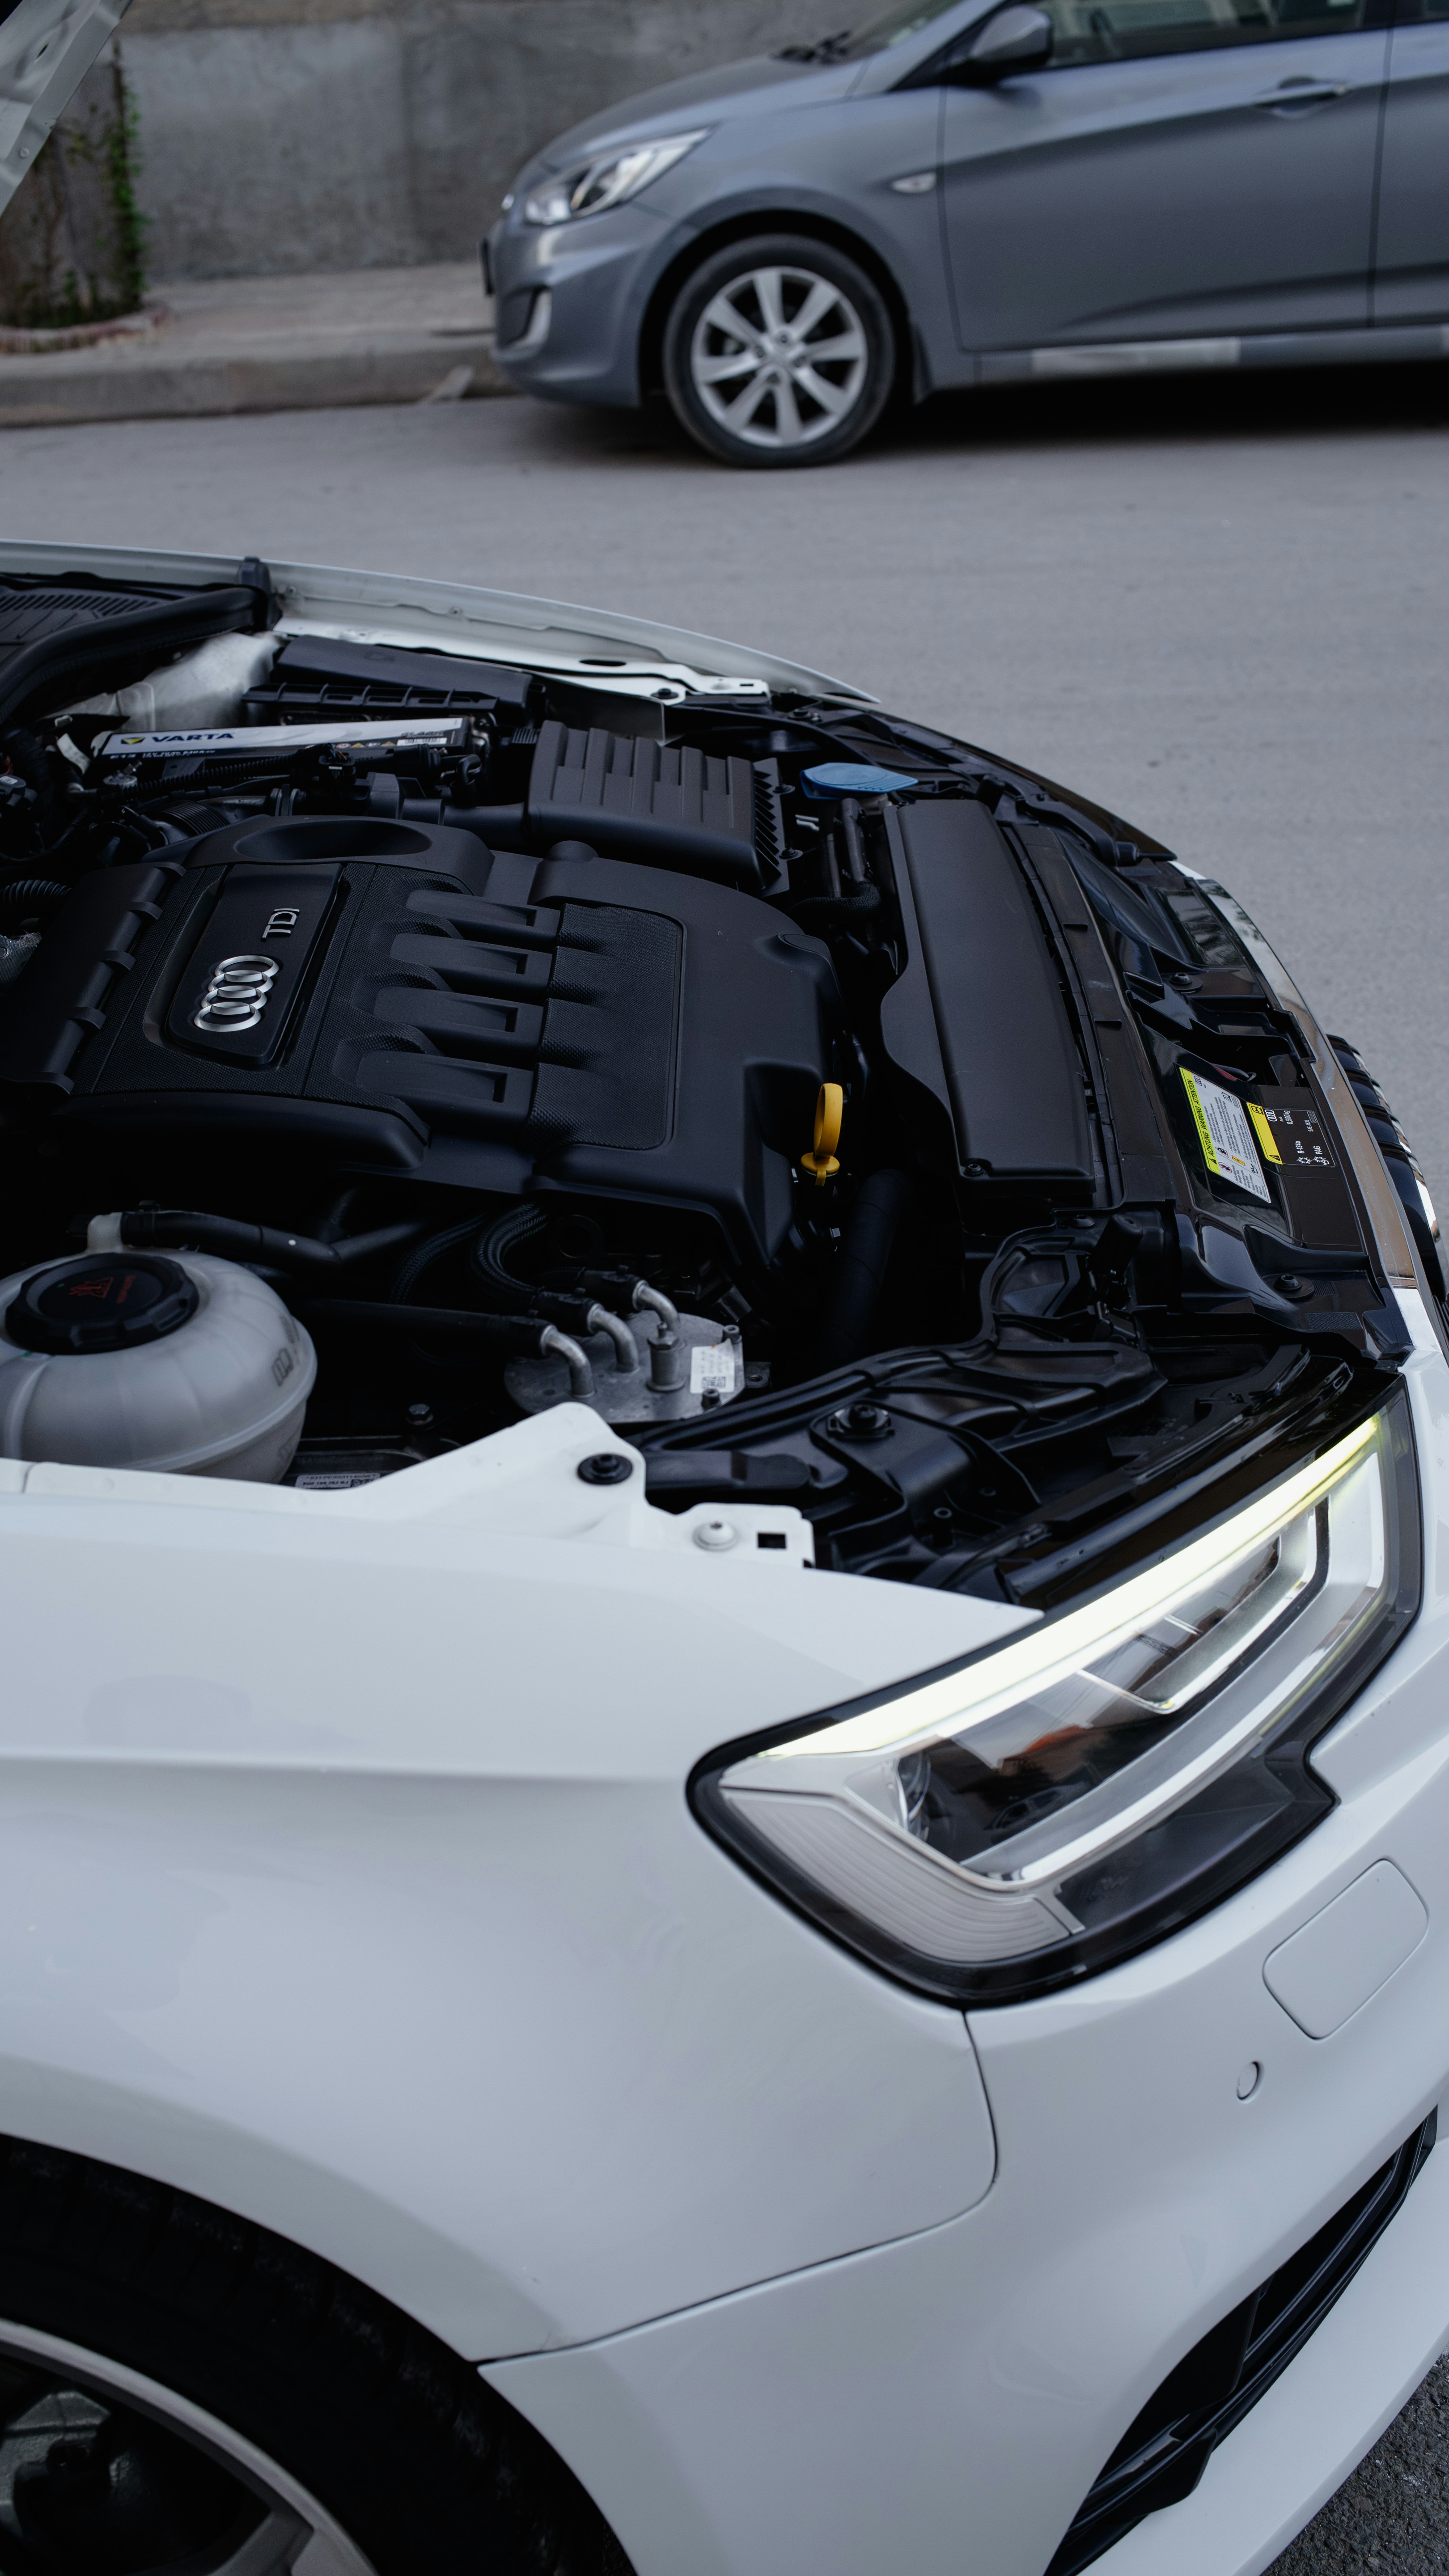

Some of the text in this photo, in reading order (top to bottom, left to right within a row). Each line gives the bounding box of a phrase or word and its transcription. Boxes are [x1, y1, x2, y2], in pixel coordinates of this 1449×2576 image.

[152, 732, 233, 742] VARTA
[262, 908, 301, 938] TDI
[1187, 1079, 1199, 1105] ATTENTION
[1195, 1106, 1208, 1130] WARNING
[1203, 1131, 1215, 1157] ACHTUNG
[1295, 1141, 1305, 1154] R-134a
[1313, 1146, 1323, 1154] PAG
